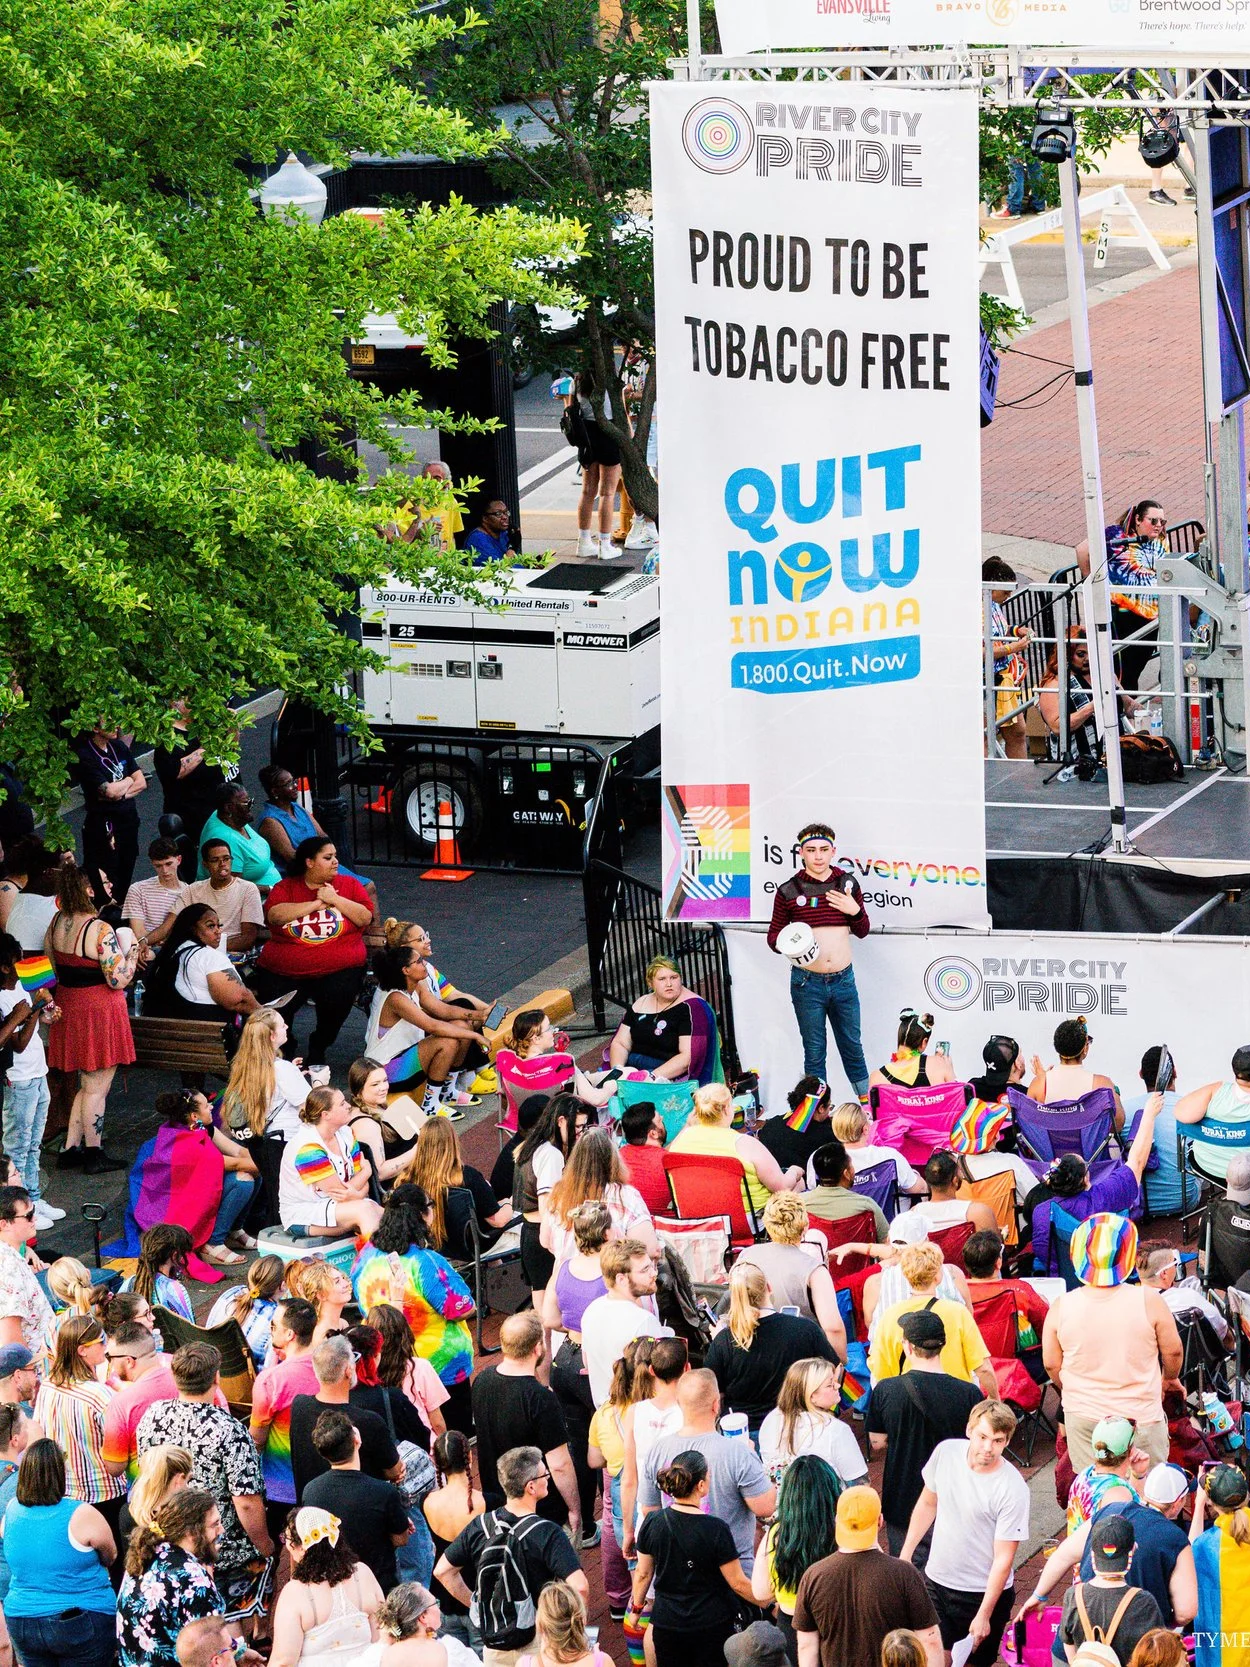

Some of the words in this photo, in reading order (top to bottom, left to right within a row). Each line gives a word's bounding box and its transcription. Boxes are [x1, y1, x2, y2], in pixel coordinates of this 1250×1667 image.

[817, 0, 891, 14] EVANSVILLE
[936, 3, 981, 11] BRAVO
[1024, 4, 1067, 12] MEDIA
[1139, 0, 1221, 11] Brentwood
[862, 9, 891, 25] Living
[1139, 21, 1168, 31] There's
[1195, 21, 1223, 31] There's
[756, 102, 856, 132] RIVER
[861, 107, 922, 137] CITY
[756, 134, 923, 187] PRIDE
[688, 228, 811, 293] PROUD
[825, 237, 870, 297] TO
[882, 242, 930, 300] BE
[684, 315, 848, 387] TOBACCO
[861, 332, 950, 391] FREE
[724, 444, 921, 544] QUIT
[376, 591, 456, 606] 800-UR-RENTS
[534, 600, 570, 610] Rentals
[398, 625, 415, 637] 25
[566, 634, 584, 646] MQ
[585, 635, 625, 647] POWER
[763, 835, 783, 866] is
[862, 890, 913, 908] egion
[301, 923, 337, 939] AF
[982, 957, 1065, 979] RIVER
[1068, 959, 1128, 981] CITY
[982, 980, 1128, 1016] PRIDE
[1201, 1125, 1224, 1137] RURAL
[1225, 1129, 1246, 1138] KING
